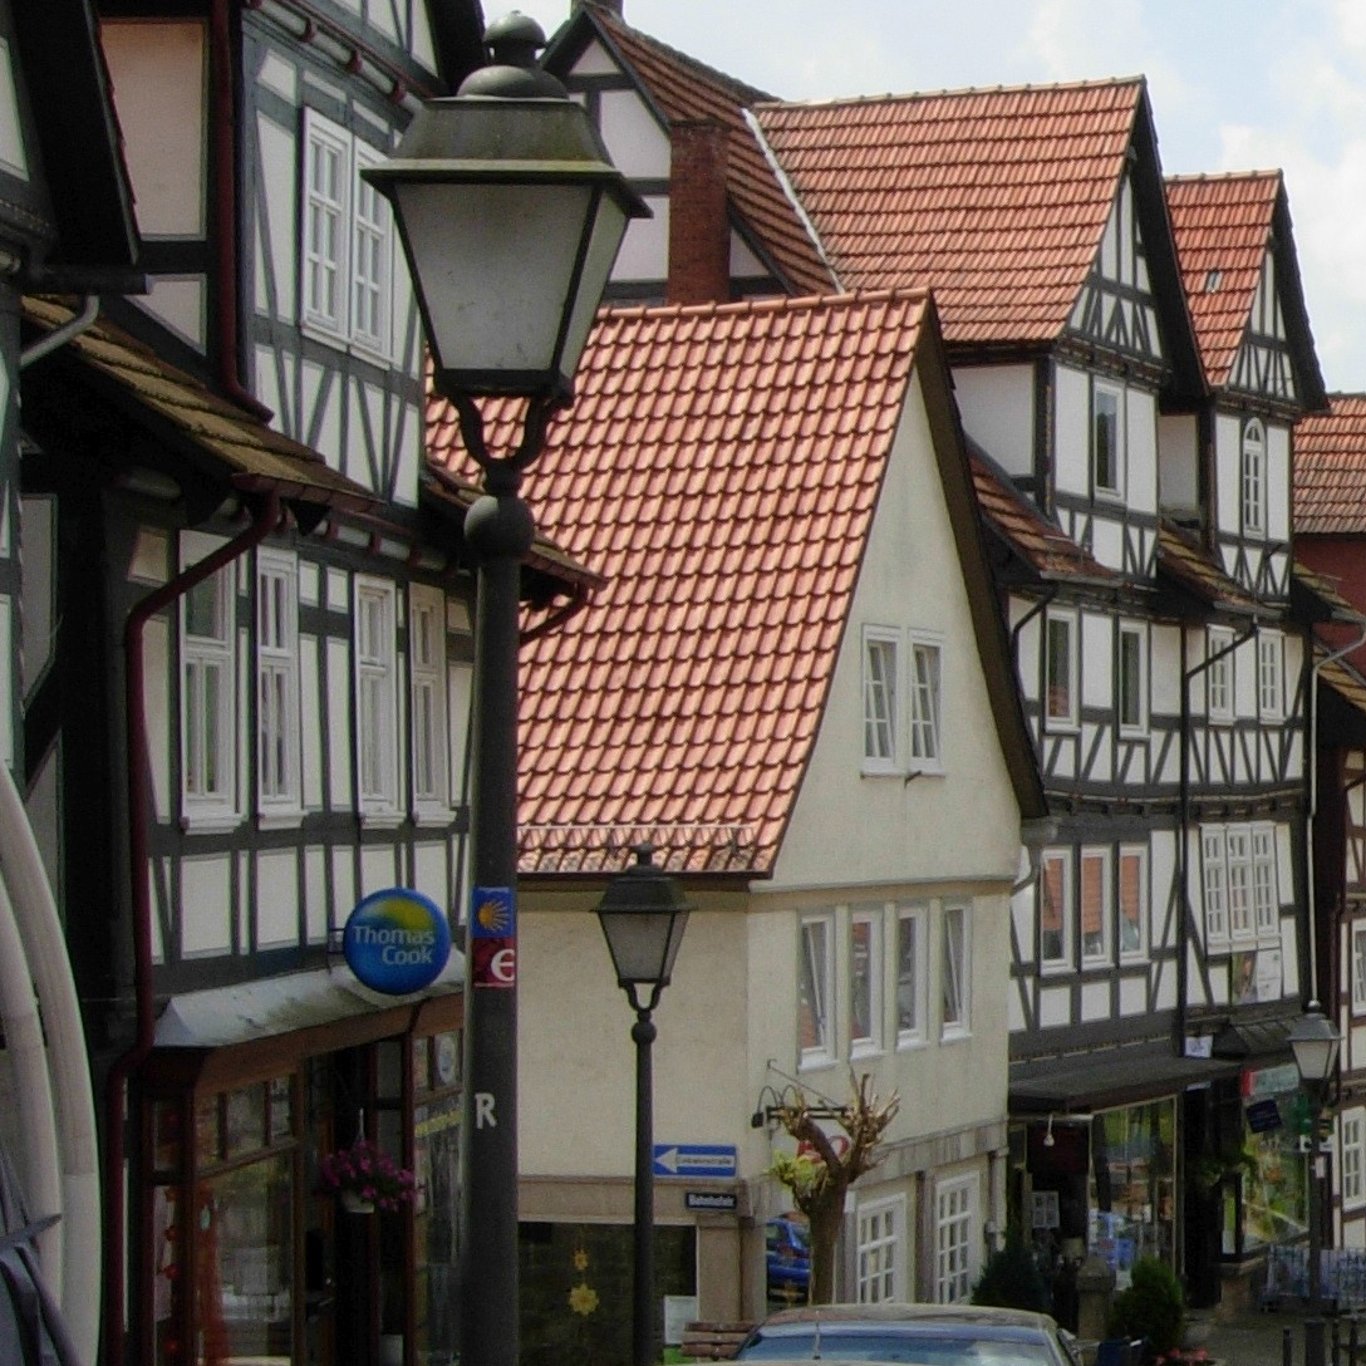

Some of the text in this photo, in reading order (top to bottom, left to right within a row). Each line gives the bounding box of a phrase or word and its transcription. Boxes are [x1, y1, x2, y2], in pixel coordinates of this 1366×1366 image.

[353, 925, 434, 945] Thomas
[382, 945, 432, 965] Cook
[474, 1092, 497, 1129] R
